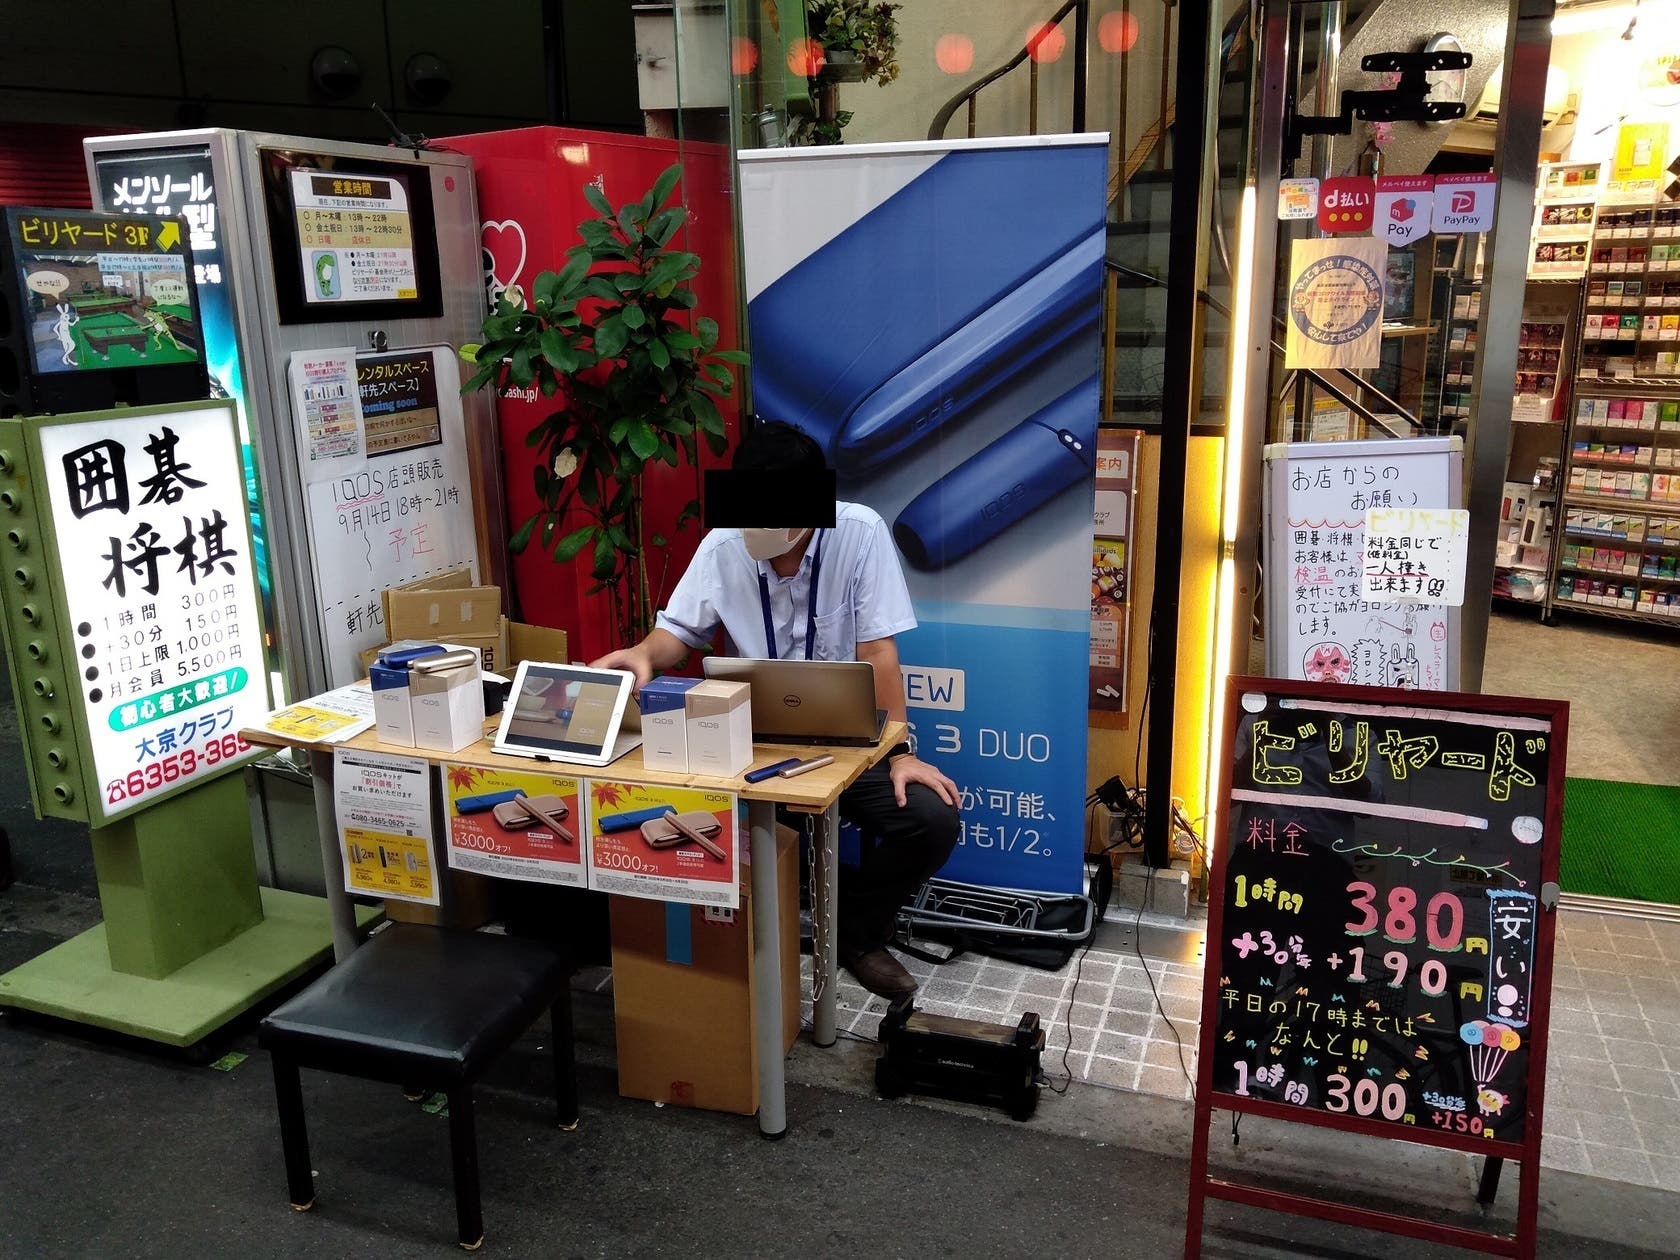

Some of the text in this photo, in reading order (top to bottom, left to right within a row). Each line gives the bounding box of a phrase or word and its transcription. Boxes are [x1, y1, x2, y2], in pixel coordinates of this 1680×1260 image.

[113, 172, 213, 206] メンソール
[332, 180, 373, 196] 営業時間
[1323, 189, 1370, 208] d払い
[21, 220, 149, 247] ビリヤード 3F
[1387, 223, 1413, 238] Pay
[1443, 215, 1481, 226] PayPay
[361, 398, 418, 413] oming soon
[62, 426, 208, 520] 囲碁
[1291, 465, 1400, 491] お店からの
[1350, 489, 1418, 511] お願い
[338, 501, 391, 535] 9月14日
[101, 509, 238, 598] 将棋
[389, 522, 434, 562] 予定
[1294, 549, 1348, 564] お客様は
[1367, 536, 1442, 550] 料金同じで
[1294, 566, 1333, 583] 検温
[104, 583, 235, 631] 1時間 300円
[185, 604, 238, 632] 150円
[1298, 616, 1337, 637] します。
[106, 644, 170, 676] 1日上限
[109, 668, 165, 699] 月会員
[901, 672, 953, 703] EW
[135, 704, 235, 763] 大京クラブ
[652, 717, 720, 729] IQOS IQOS
[935, 724, 962, 753] 3
[979, 728, 1050, 762] DUO
[1252, 720, 1546, 801] ビリヤード
[552, 779, 575, 788] IQOS
[704, 794, 728, 803] IQOS
[1247, 816, 1310, 857] 料金
[1234, 874, 1304, 914] 1時間
[1221, 988, 1418, 1037] 平日の17時までは
[1233, 1060, 1310, 1106] 1時間
